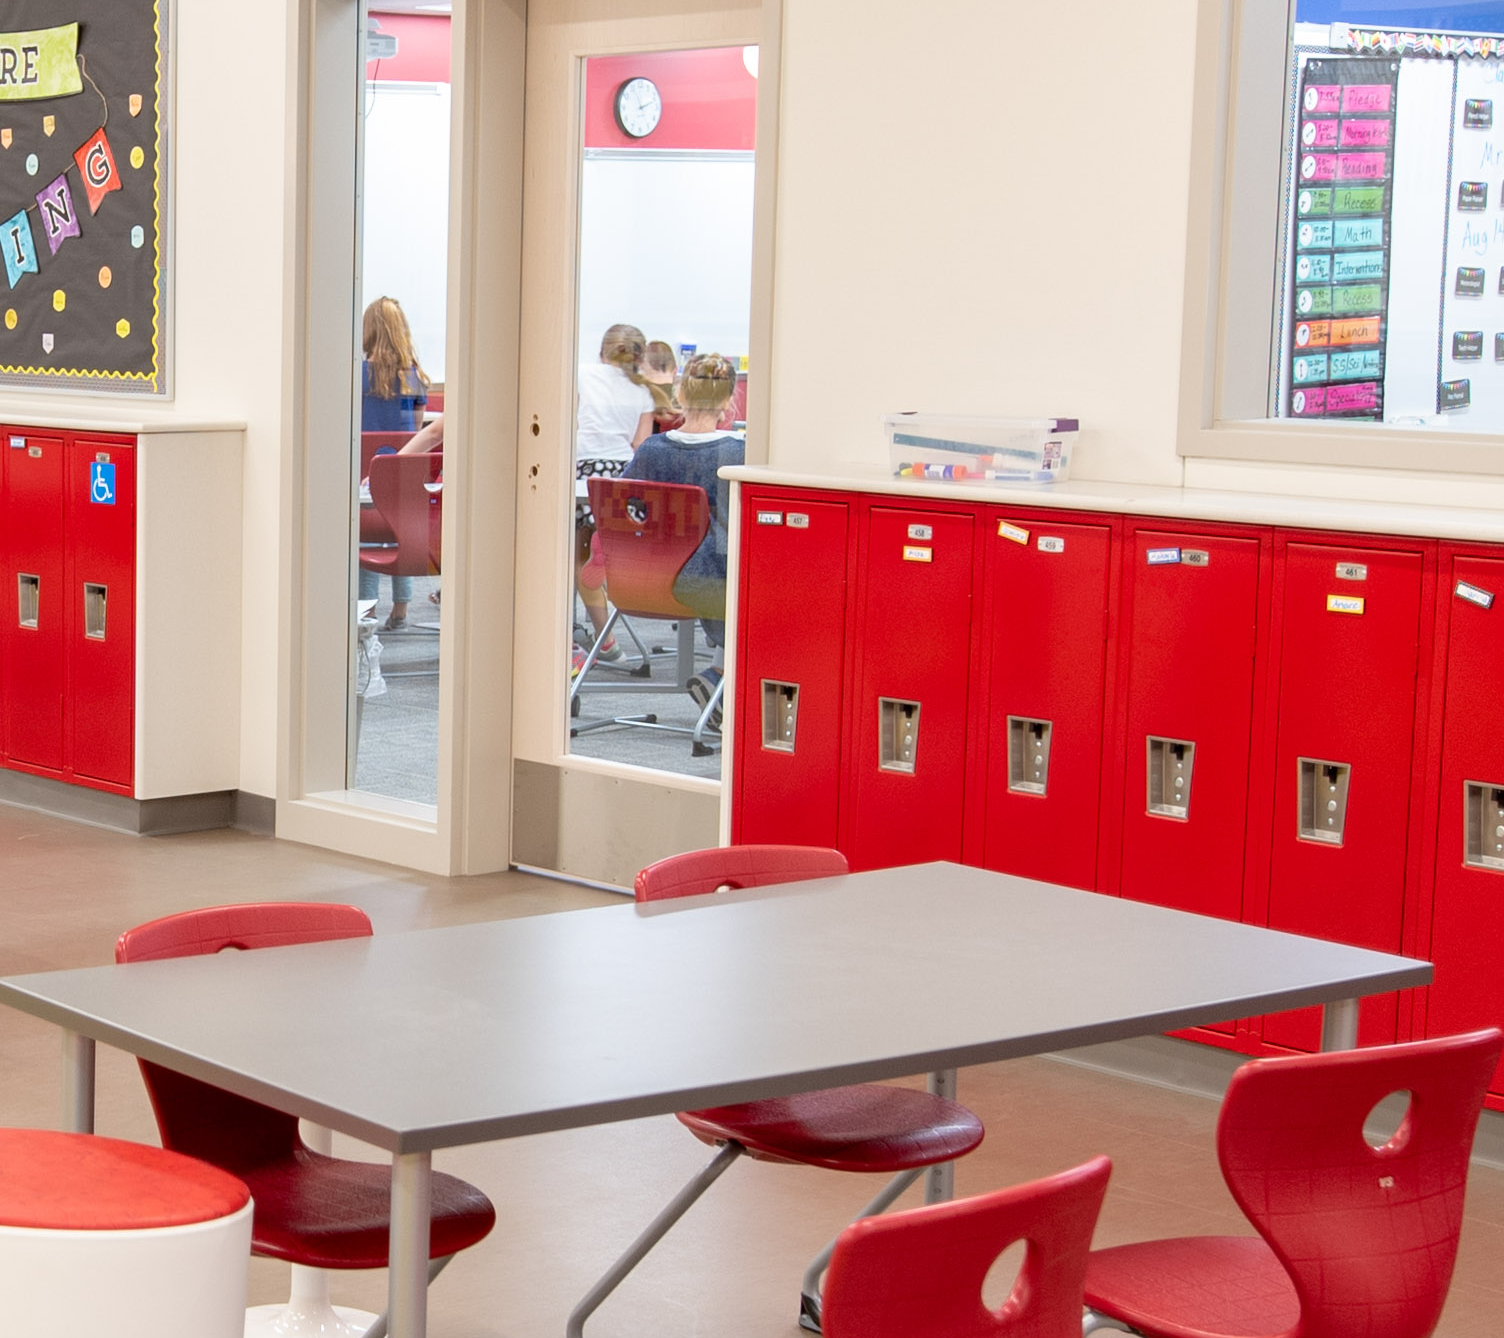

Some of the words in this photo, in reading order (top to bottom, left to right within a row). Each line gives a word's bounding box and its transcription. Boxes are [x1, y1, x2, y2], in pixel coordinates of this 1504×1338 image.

[1344, 192, 1377, 209] Recess
[1344, 226, 1372, 242] Math
[1461, 220, 1489, 256] Aug
[1343, 290, 1373, 306] Recess
[1340, 325, 1368, 339] Lunch
[1044, 541, 1056, 550] 459
